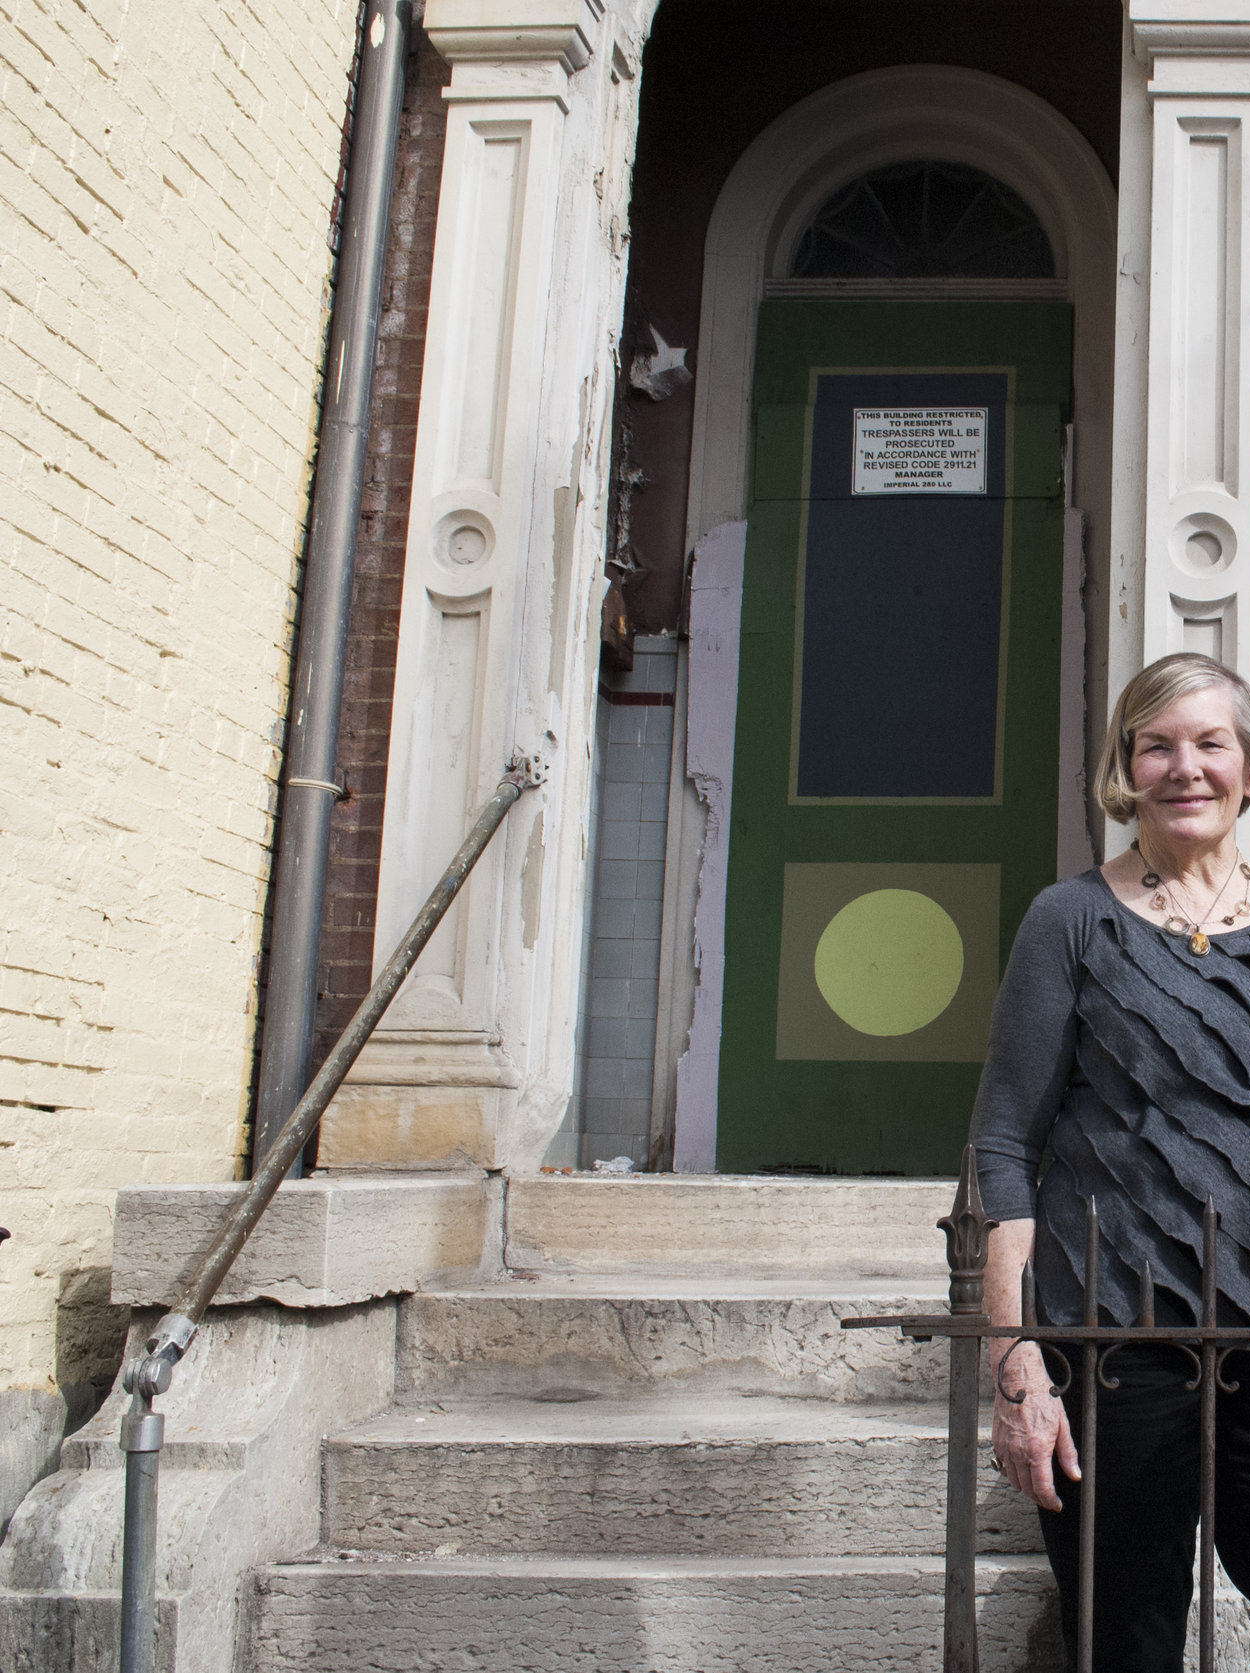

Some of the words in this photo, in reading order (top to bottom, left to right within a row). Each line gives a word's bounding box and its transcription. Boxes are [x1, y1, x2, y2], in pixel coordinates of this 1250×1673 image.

[862, 429, 935, 438] TRESPASSERS
[938, 429, 963, 437] WILL
[966, 428, 980, 437] BE
[885, 439, 955, 448] PROSECUTED
[864, 452, 874, 460] IN
[877, 450, 947, 459] ACCORDANCE
[950, 450, 976, 458] WITH
[863, 461, 908, 470] REVISED
[911, 461, 940, 469] CODE
[944, 460, 976, 469] 2911.21
